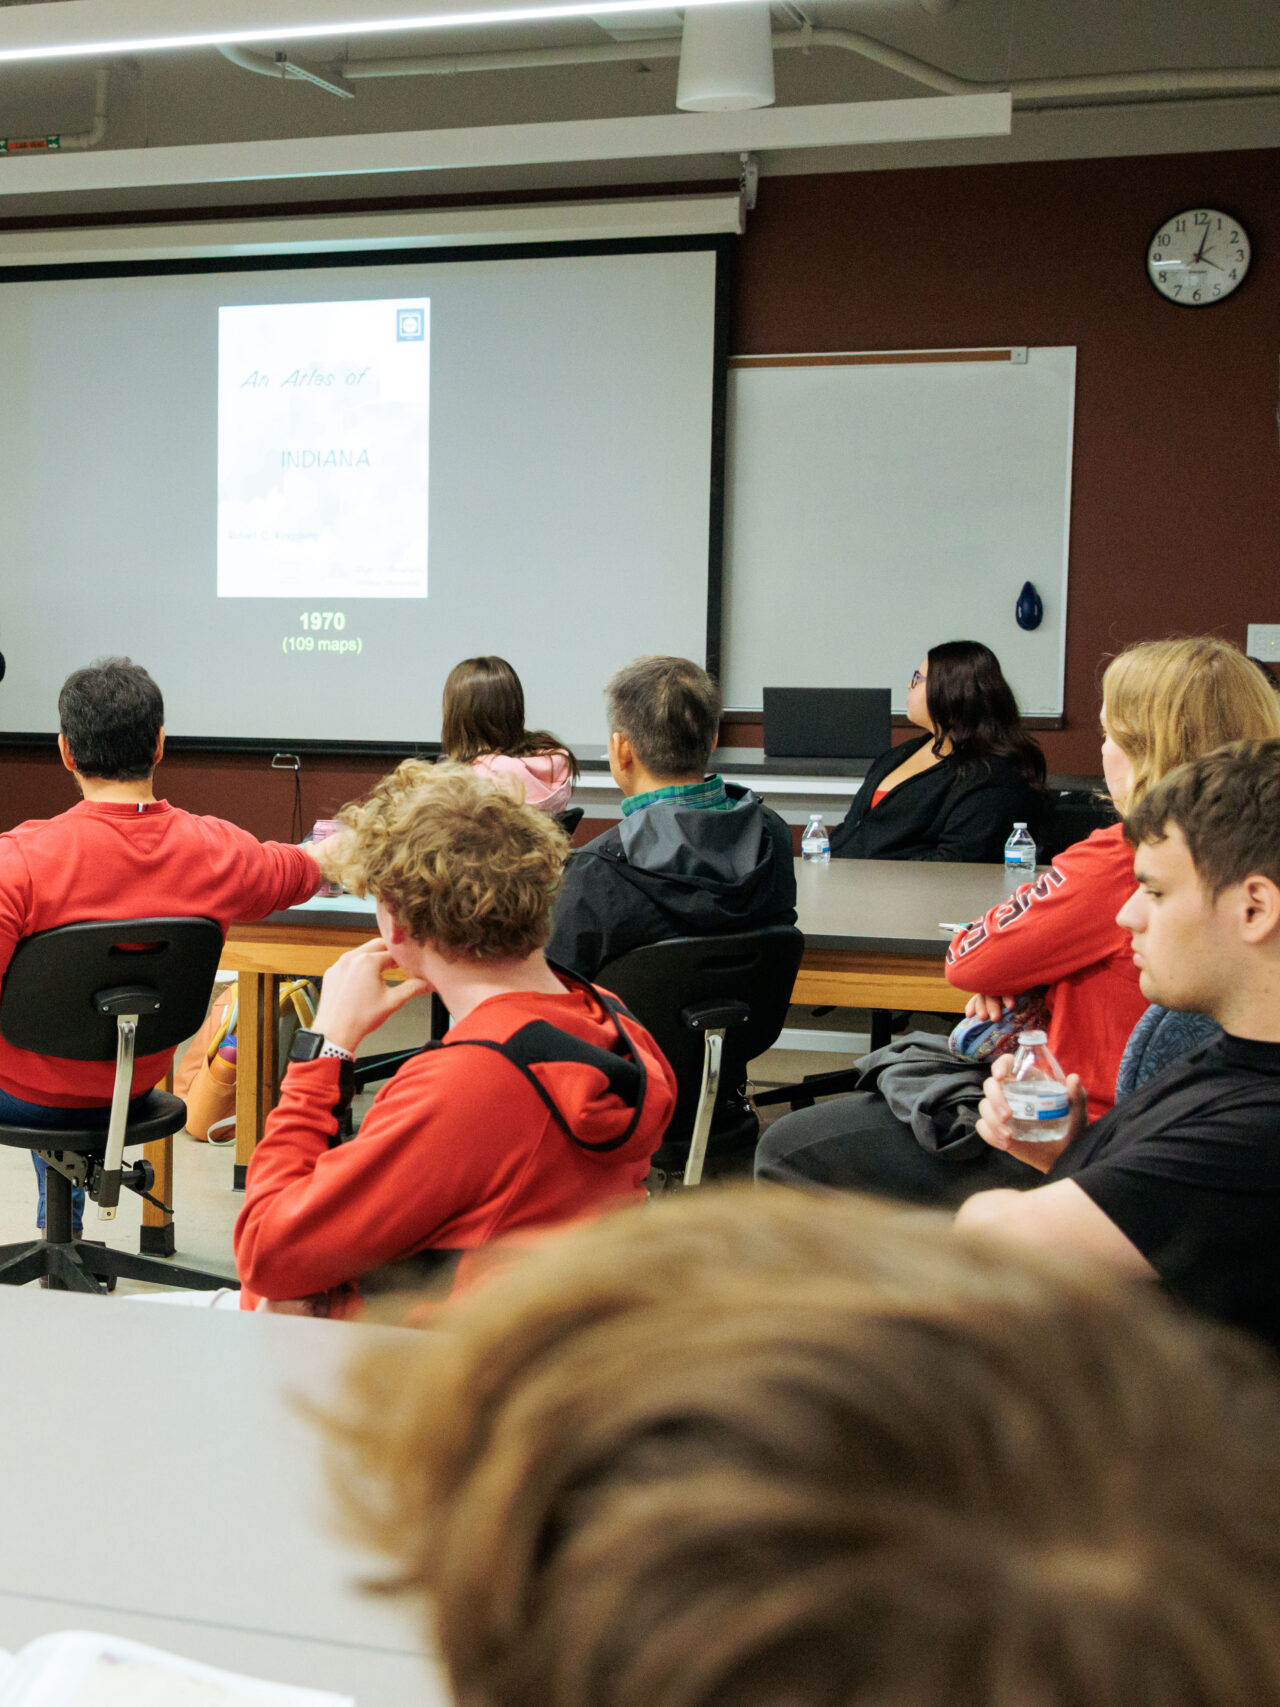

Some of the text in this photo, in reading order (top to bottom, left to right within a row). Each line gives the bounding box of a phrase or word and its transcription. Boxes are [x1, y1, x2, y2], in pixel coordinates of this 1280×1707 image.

[1175, 219, 1187, 233] 11
[1193, 212, 1209, 226] 12
[1217, 218, 1223, 231] 1
[1157, 233, 1171, 247] 10
[1230, 230, 1239, 244] 2
[1152, 252, 1162, 264] 9
[1235, 249, 1245, 263] 3
[1158, 271, 1168, 284] 8
[1228, 267, 1237, 281] 4
[1173, 284, 1183, 298] 7
[1192, 288, 1202, 302] 6
[1212, 283, 1222, 297] 5
[239, 365, 372, 390] An Atlas of
[280, 448, 371, 469] INDIANA
[298, 611, 347, 631] 1970
[281, 636, 364, 655] (109 maps)
